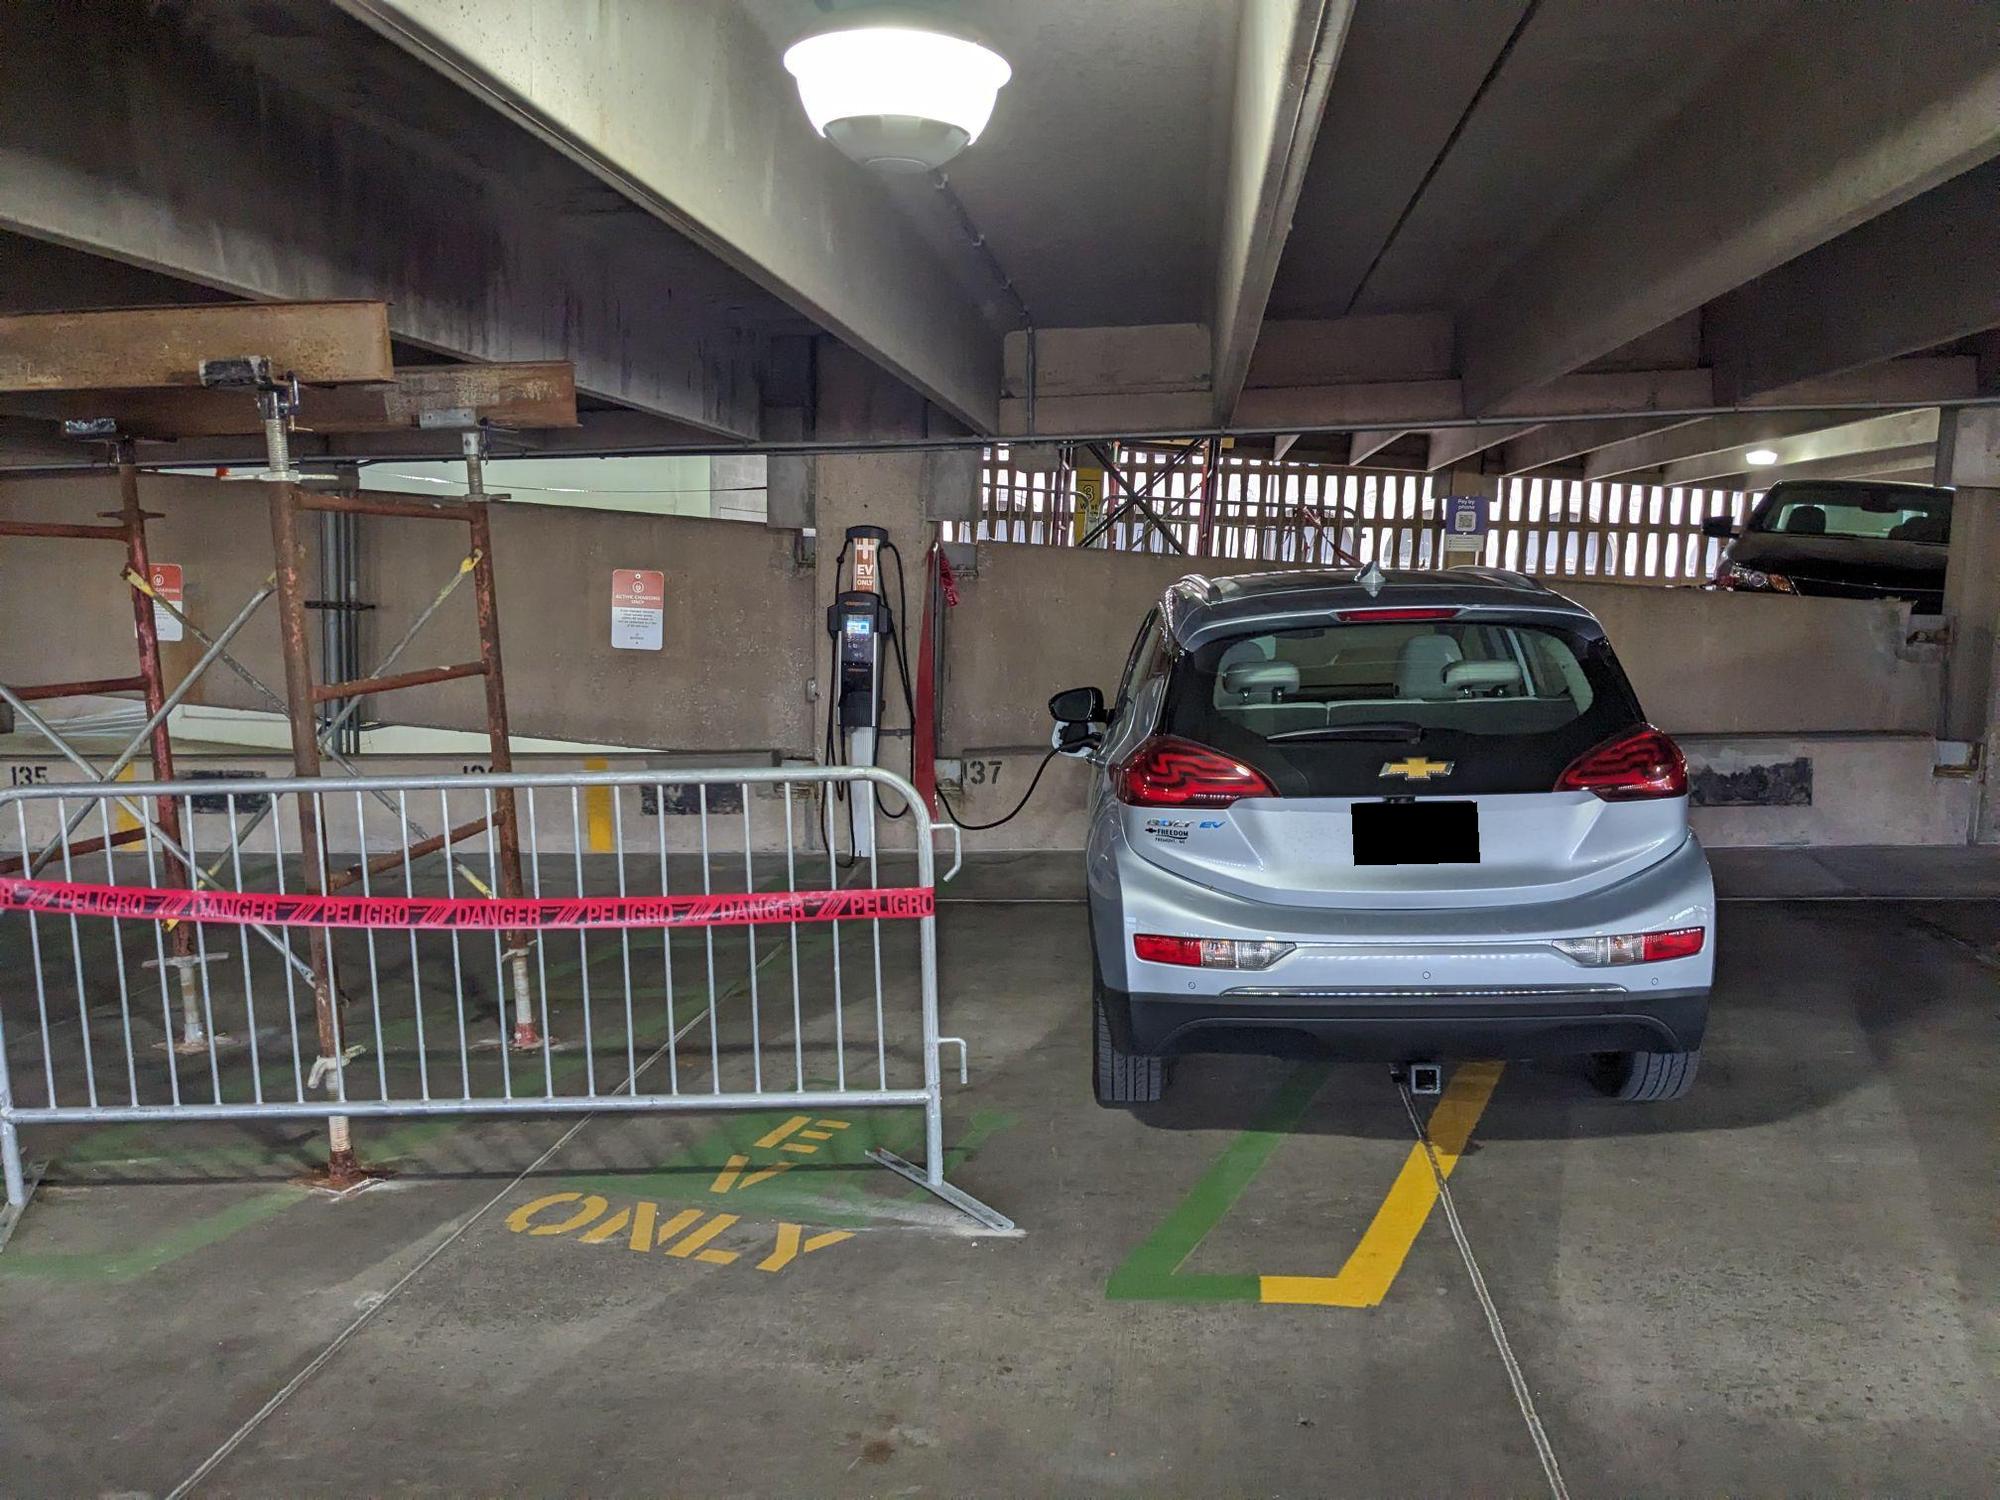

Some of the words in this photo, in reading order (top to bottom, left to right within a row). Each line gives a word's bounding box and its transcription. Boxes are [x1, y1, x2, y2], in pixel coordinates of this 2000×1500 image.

[1083, 484, 1095, 502] 3
[856, 564, 874, 576] EV
[963, 760, 1003, 785] 137
[1157, 828, 1188, 837] FREEDOM
[1199, 820, 1226, 829] EV
[57, 889, 146, 913] PELIGRO
[191, 897, 277, 921] DANGER
[322, 903, 410, 924] PELIGRO
[455, 904, 541, 925] DANGER
[586, 902, 675, 923] PELIGRO
[720, 899, 806, 921] DANGER
[849, 894, 936, 917] PELIGRO
[504, 1191, 857, 1272] ONLY
